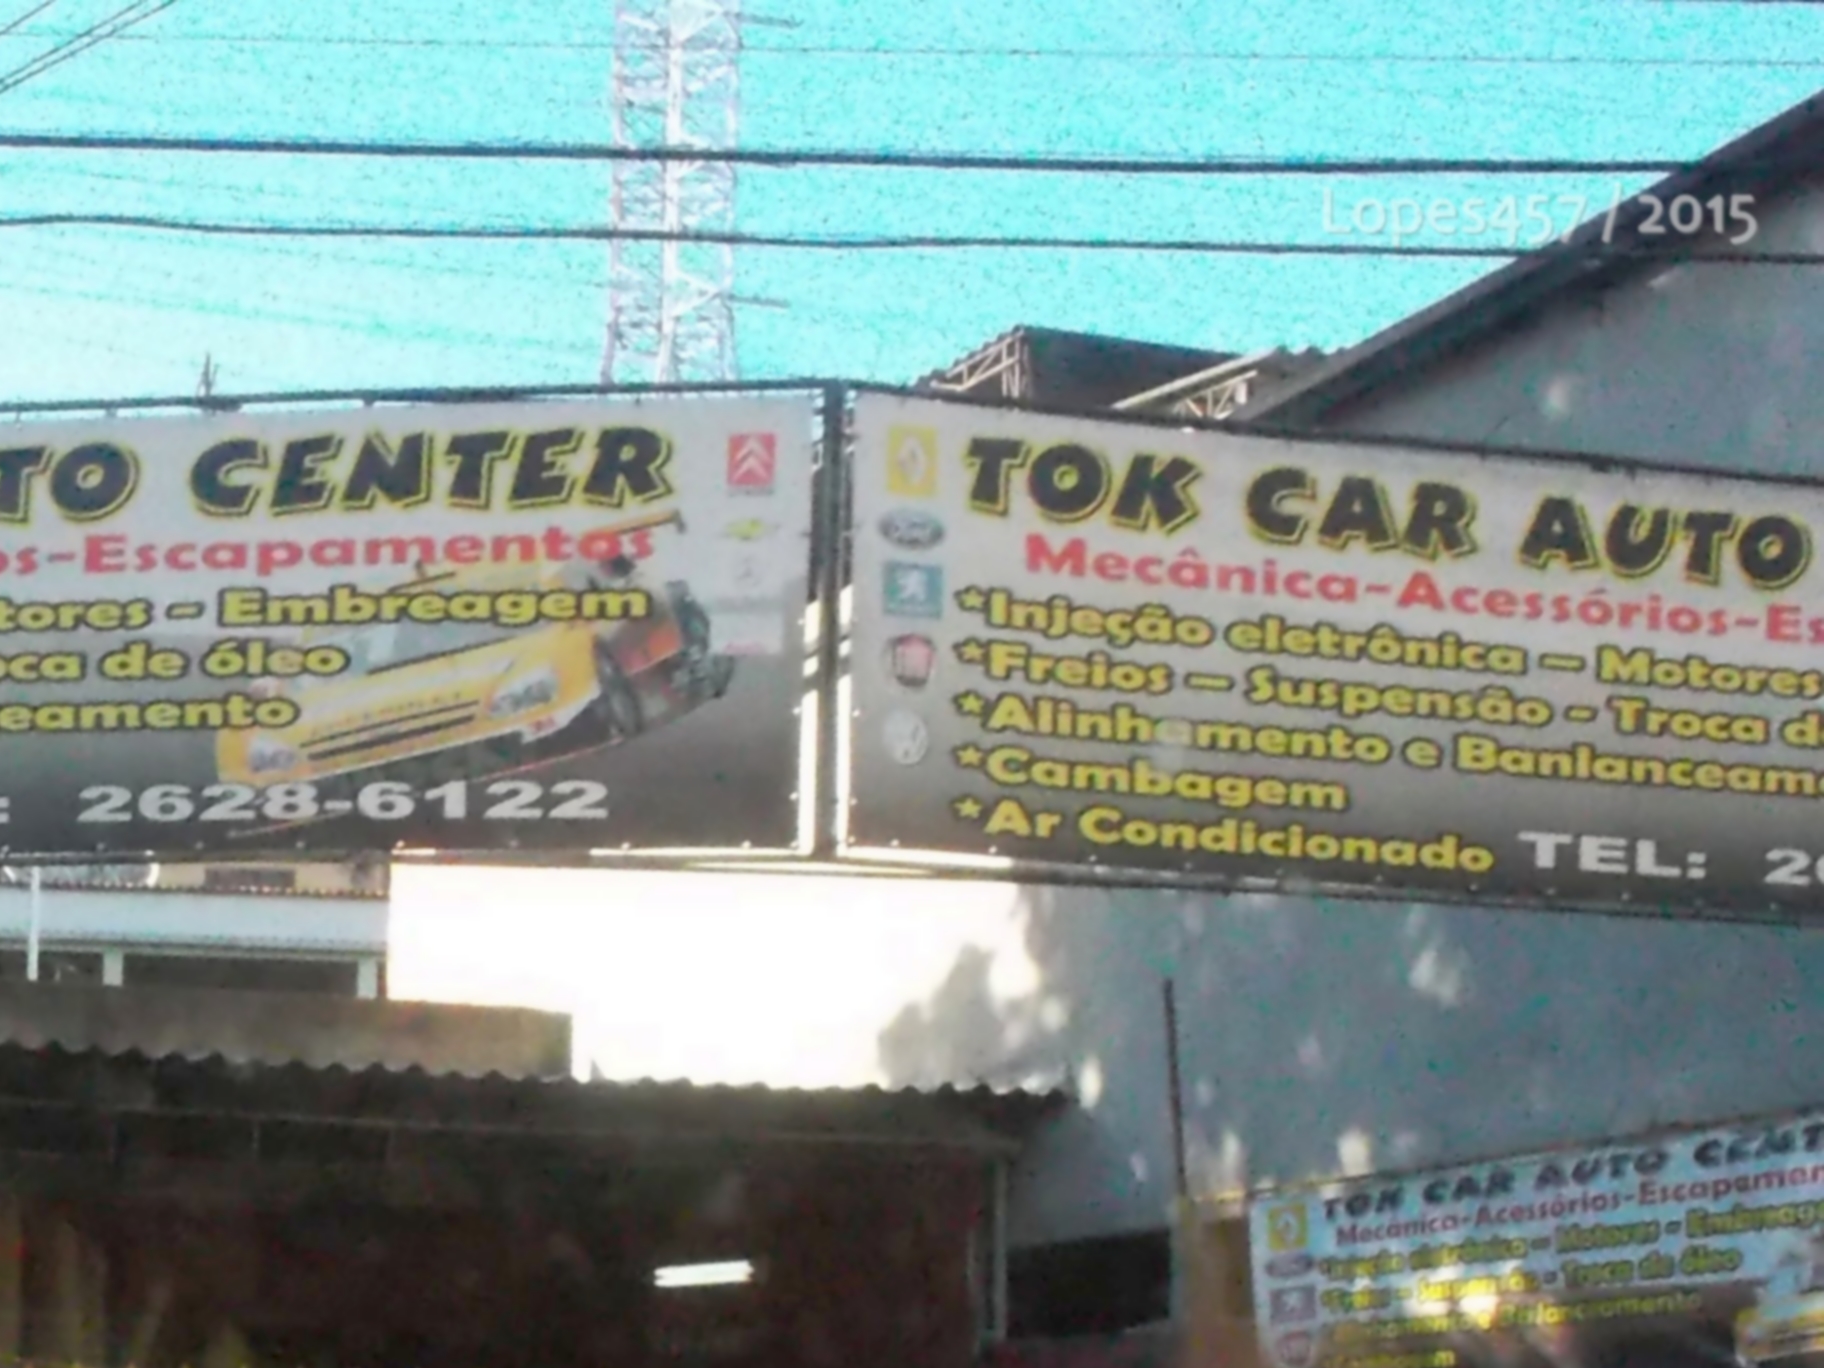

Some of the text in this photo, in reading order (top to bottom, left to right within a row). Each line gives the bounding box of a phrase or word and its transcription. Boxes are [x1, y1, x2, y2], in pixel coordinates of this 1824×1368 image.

[189, 424, 676, 518] CENTER
[963, 436, 1204, 536] TOK
[1245, 464, 1478, 563] CAR
[1517, 495, 1813, 591] AUTO
[217, 586, 652, 629] Embreagem
[98, 642, 193, 682] de
[201, 638, 350, 679] óleo
[1224, 612, 1530, 676] eletrônica
[1596, 643, 1824, 699] Motores
[1243, 662, 1555, 724] Suspensão
[1605, 694, 1770, 747] Troca
[1779, 709, 1824, 750] d
[76, 778, 611, 823] 2628-6122
[1401, 736, 1443, 768] e
[1451, 732, 1824, 798] Banlanceam
[1076, 804, 1496, 874] Condicionado
[1517, 828, 1707, 881] TEL:
[1764, 847, 1824, 888] 2
[1422, 1167, 1517, 1204] CAR
[1535, 1147, 1670, 1192] AUTO
